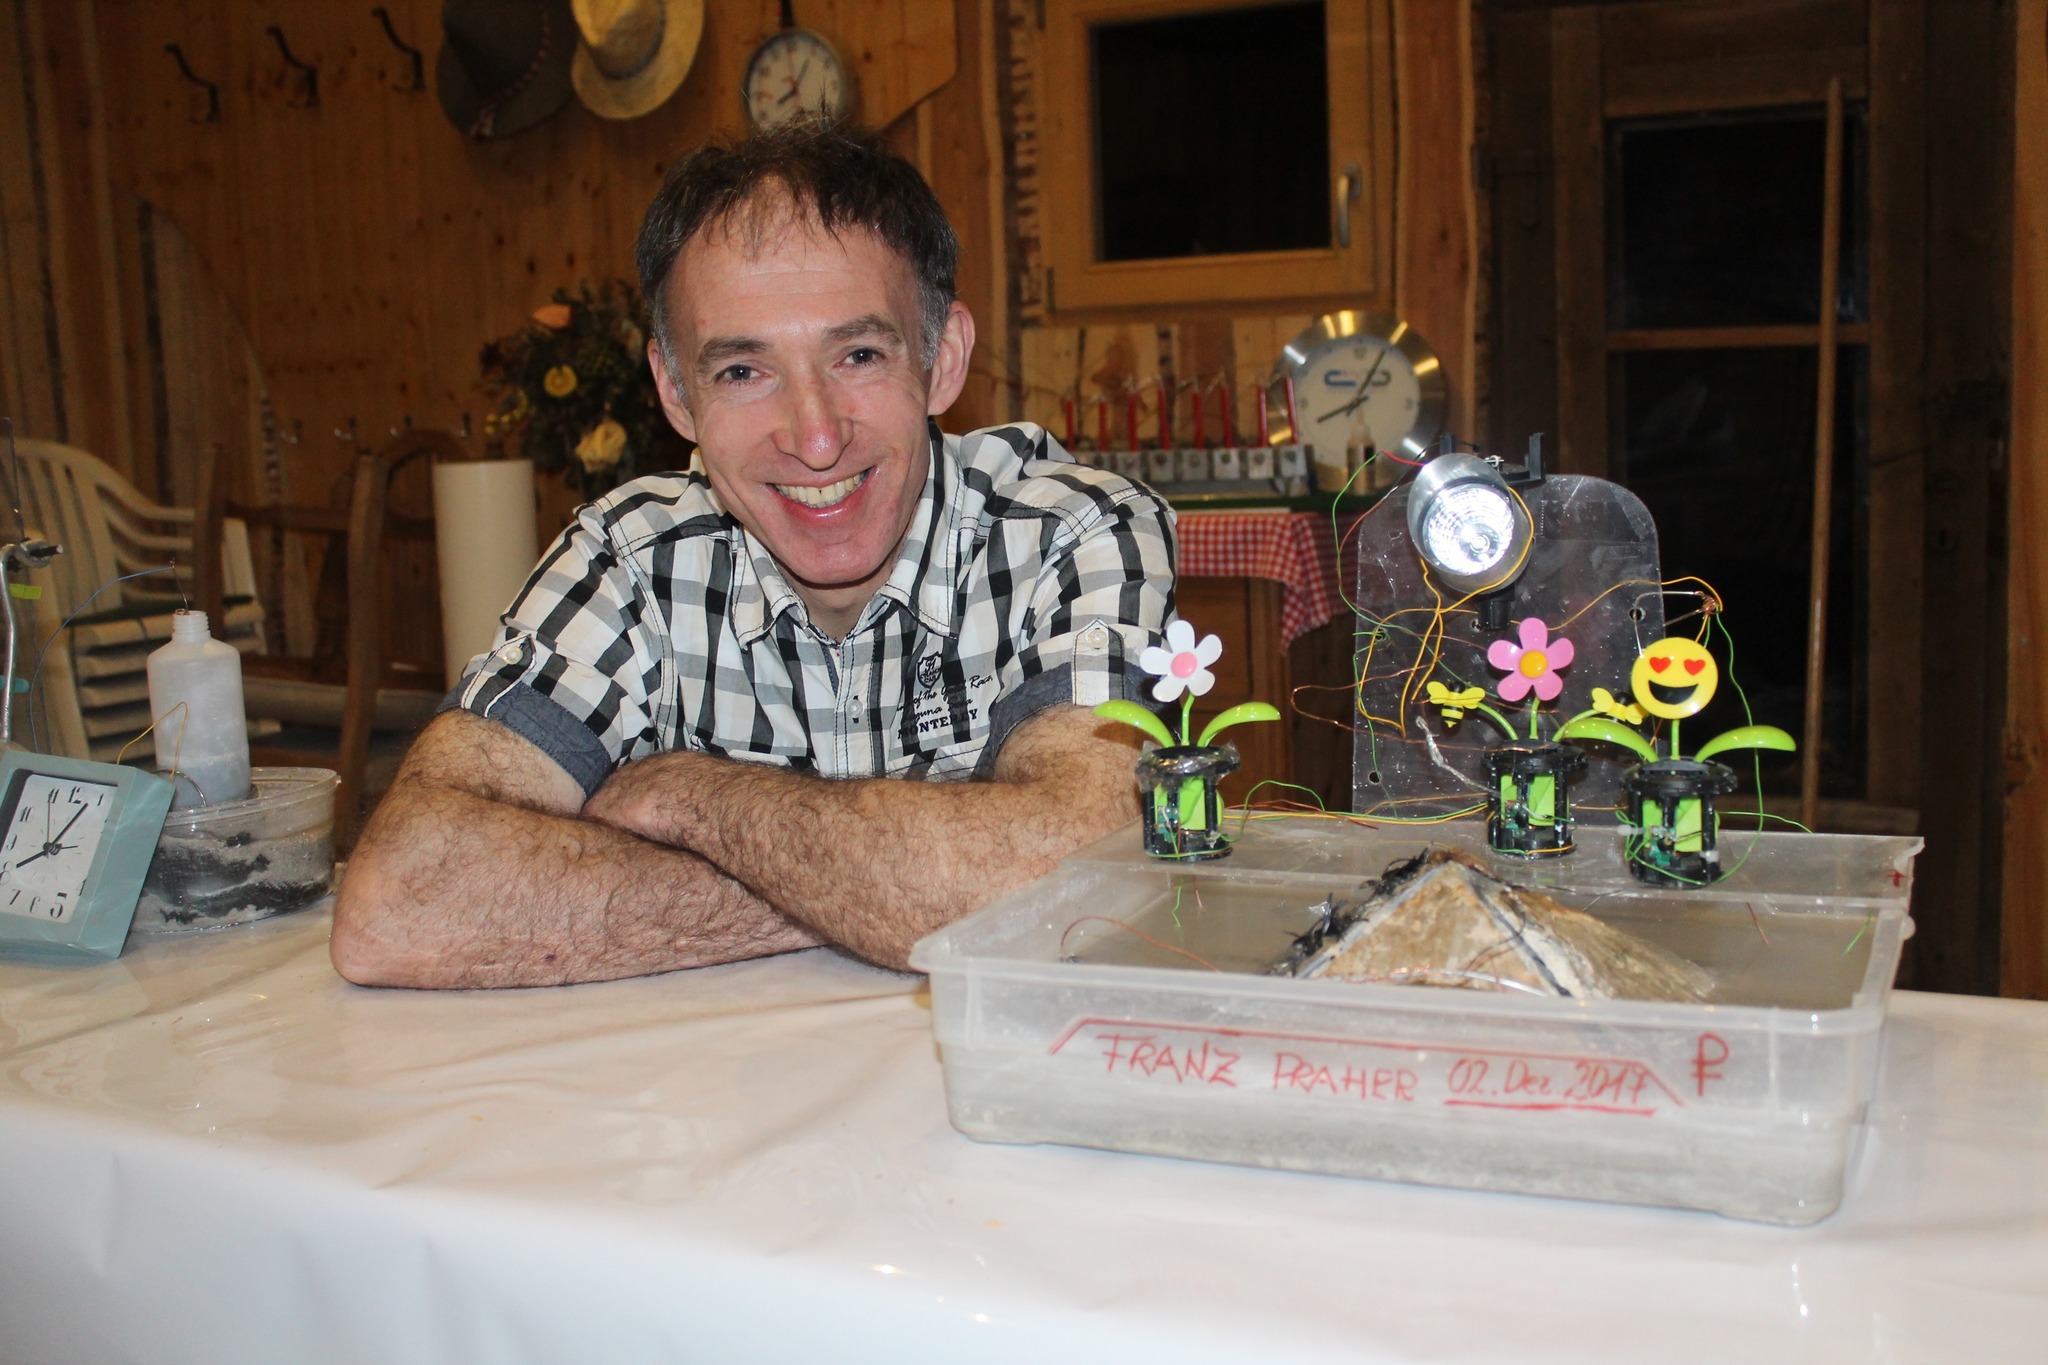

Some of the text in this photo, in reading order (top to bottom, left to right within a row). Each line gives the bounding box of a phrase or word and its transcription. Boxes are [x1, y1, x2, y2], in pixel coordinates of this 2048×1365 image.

[46, 787, 60, 804] 11
[67, 785, 86, 805] 12
[20, 806, 36, 822] 10
[6, 833, 17, 851] 9
[0, 860, 13, 885] 8
[9, 888, 21, 906] 7
[29, 896, 41, 914] 6
[50, 892, 67, 918] 5
[1096, 1034, 1240, 1088] FRANZ
[1273, 1051, 1418, 1101] PRAHER
